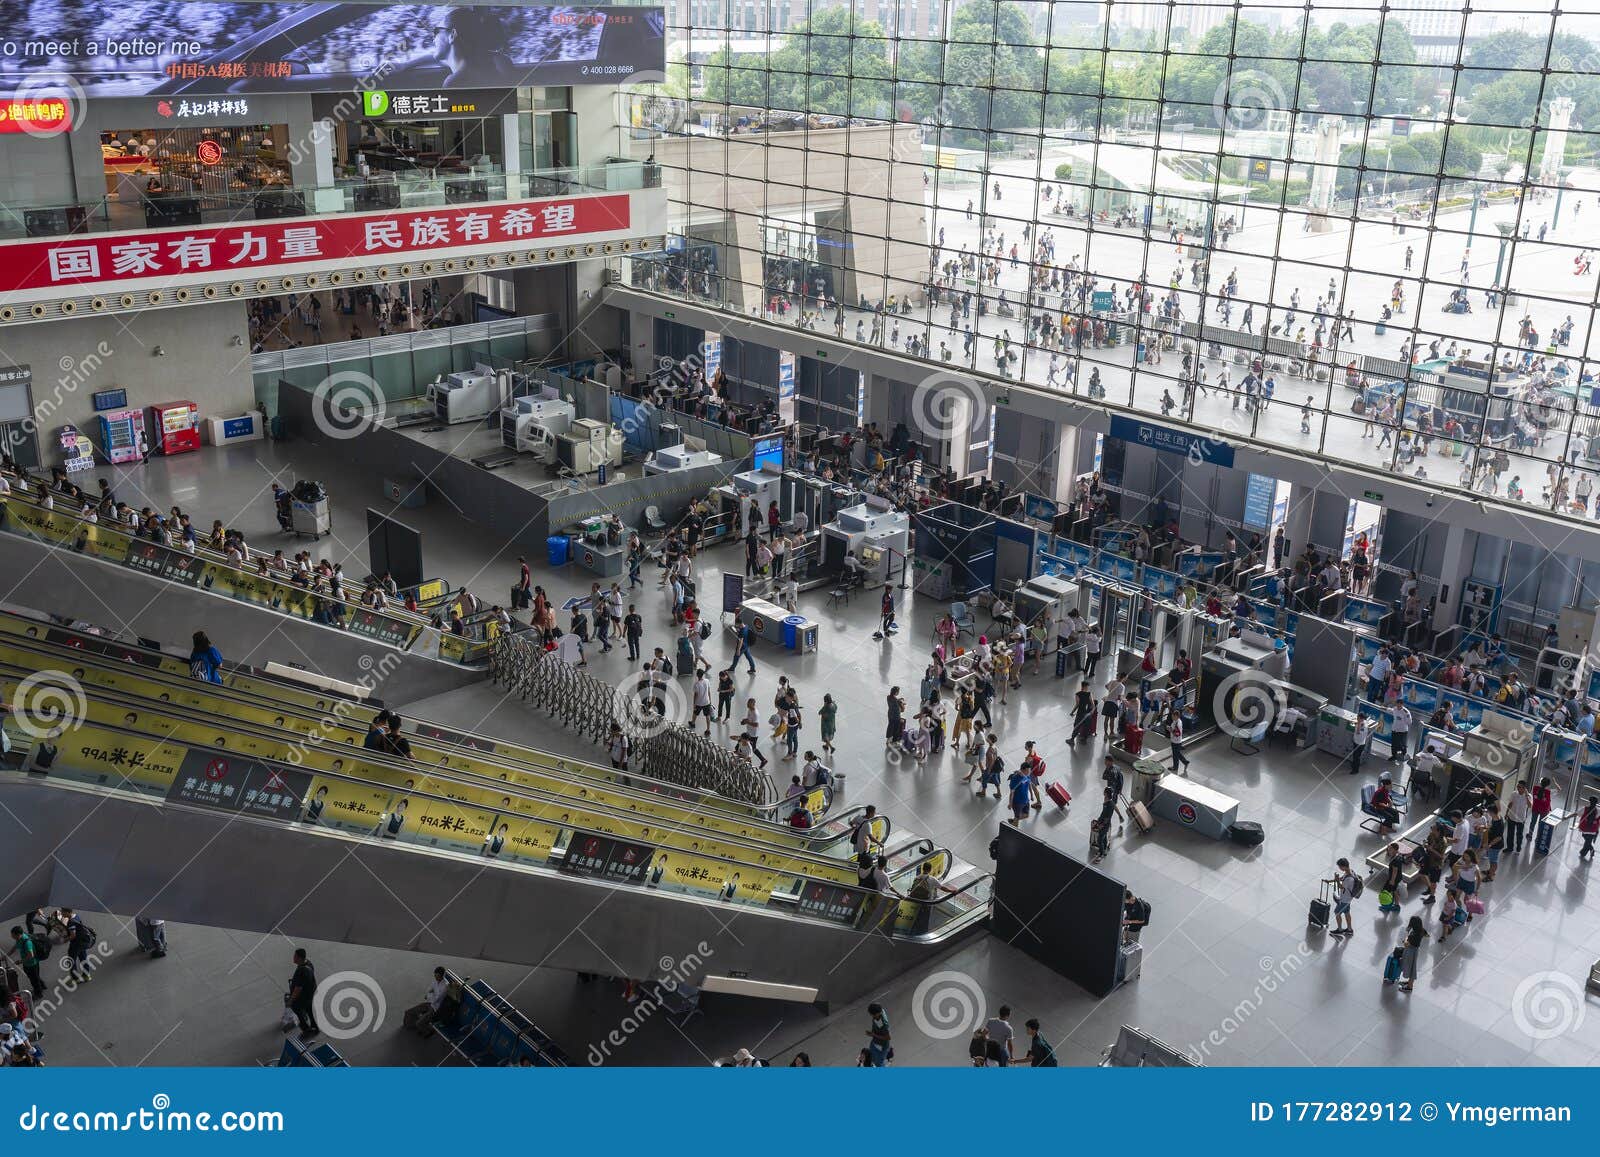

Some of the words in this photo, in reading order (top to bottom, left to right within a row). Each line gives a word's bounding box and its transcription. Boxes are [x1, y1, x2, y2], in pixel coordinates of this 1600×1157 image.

[25, 39, 79, 56] meet
[87, 42, 98, 56] a
[106, 37, 165, 56] better
[171, 40, 200, 56] me
[165, 61, 292, 80] 中国5A级医美机构
[590, 65, 603, 74] 400
[604, 65, 617, 74] 028
[617, 65, 634, 74] 6666
[8, 103, 65, 122] 绝味鸭脖
[391, 95, 449, 115] 德克士
[48, 226, 324, 282] 国家有力量
[364, 204, 577, 251] 民族有希望
